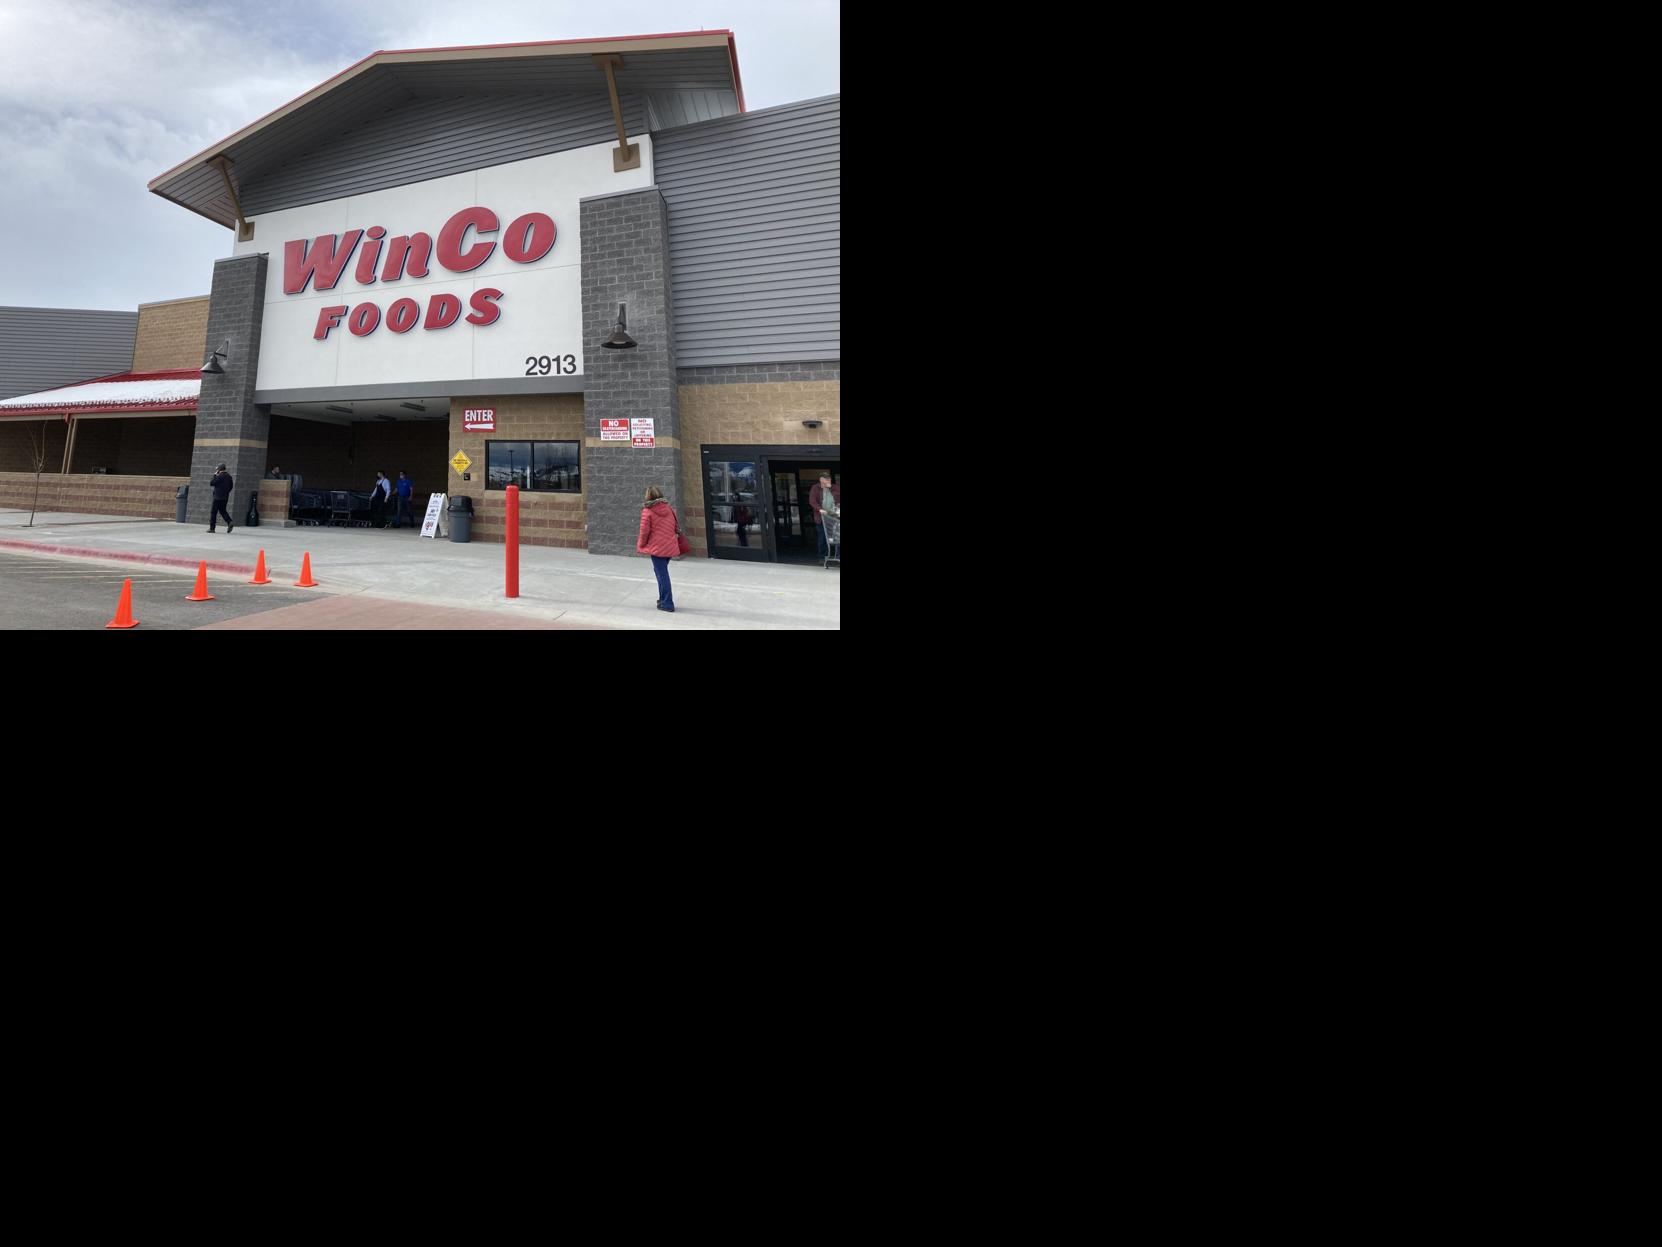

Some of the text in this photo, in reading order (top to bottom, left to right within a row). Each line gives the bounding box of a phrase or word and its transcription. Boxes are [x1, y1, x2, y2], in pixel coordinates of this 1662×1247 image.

[284, 207, 557, 295] WinCo
[313, 288, 505, 340] FOODS
[525, 354, 577, 376] 2913
[464, 409, 494, 422] ENTER
